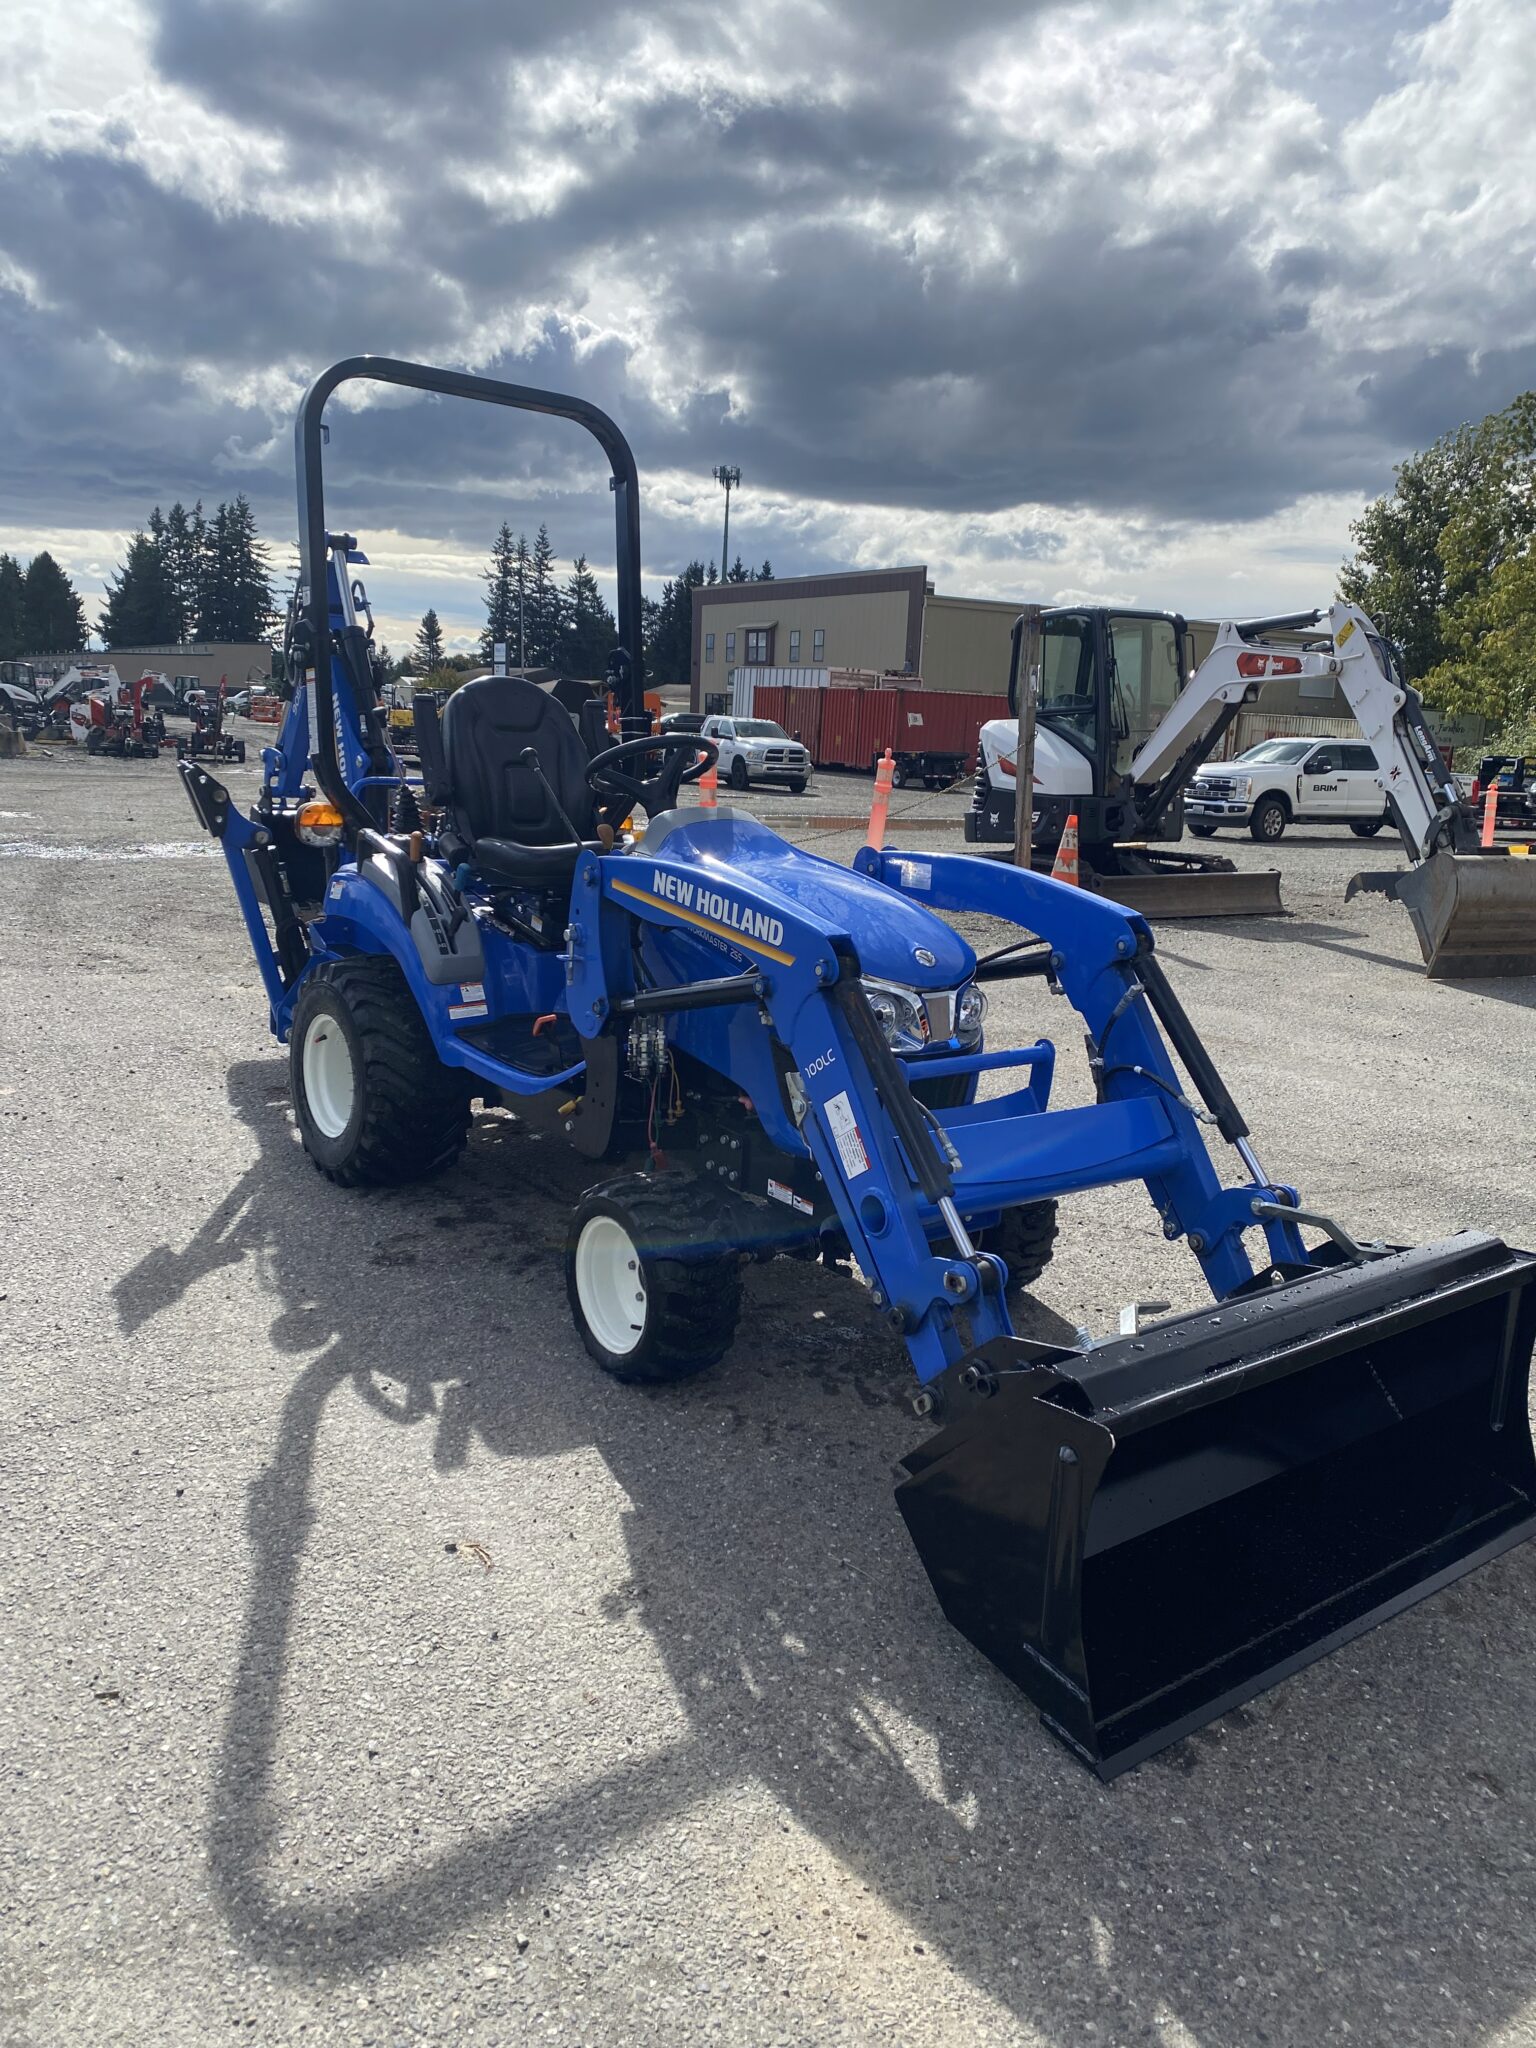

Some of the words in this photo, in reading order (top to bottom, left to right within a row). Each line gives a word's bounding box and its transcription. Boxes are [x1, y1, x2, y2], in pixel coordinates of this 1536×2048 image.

[332, 692, 344, 738] NEW
[1312, 784, 1338, 792] BRIM
[653, 869, 693, 908] NEW
[696, 887, 784, 947] HOLLAND
[804, 1048, 836, 1079] 100LC
